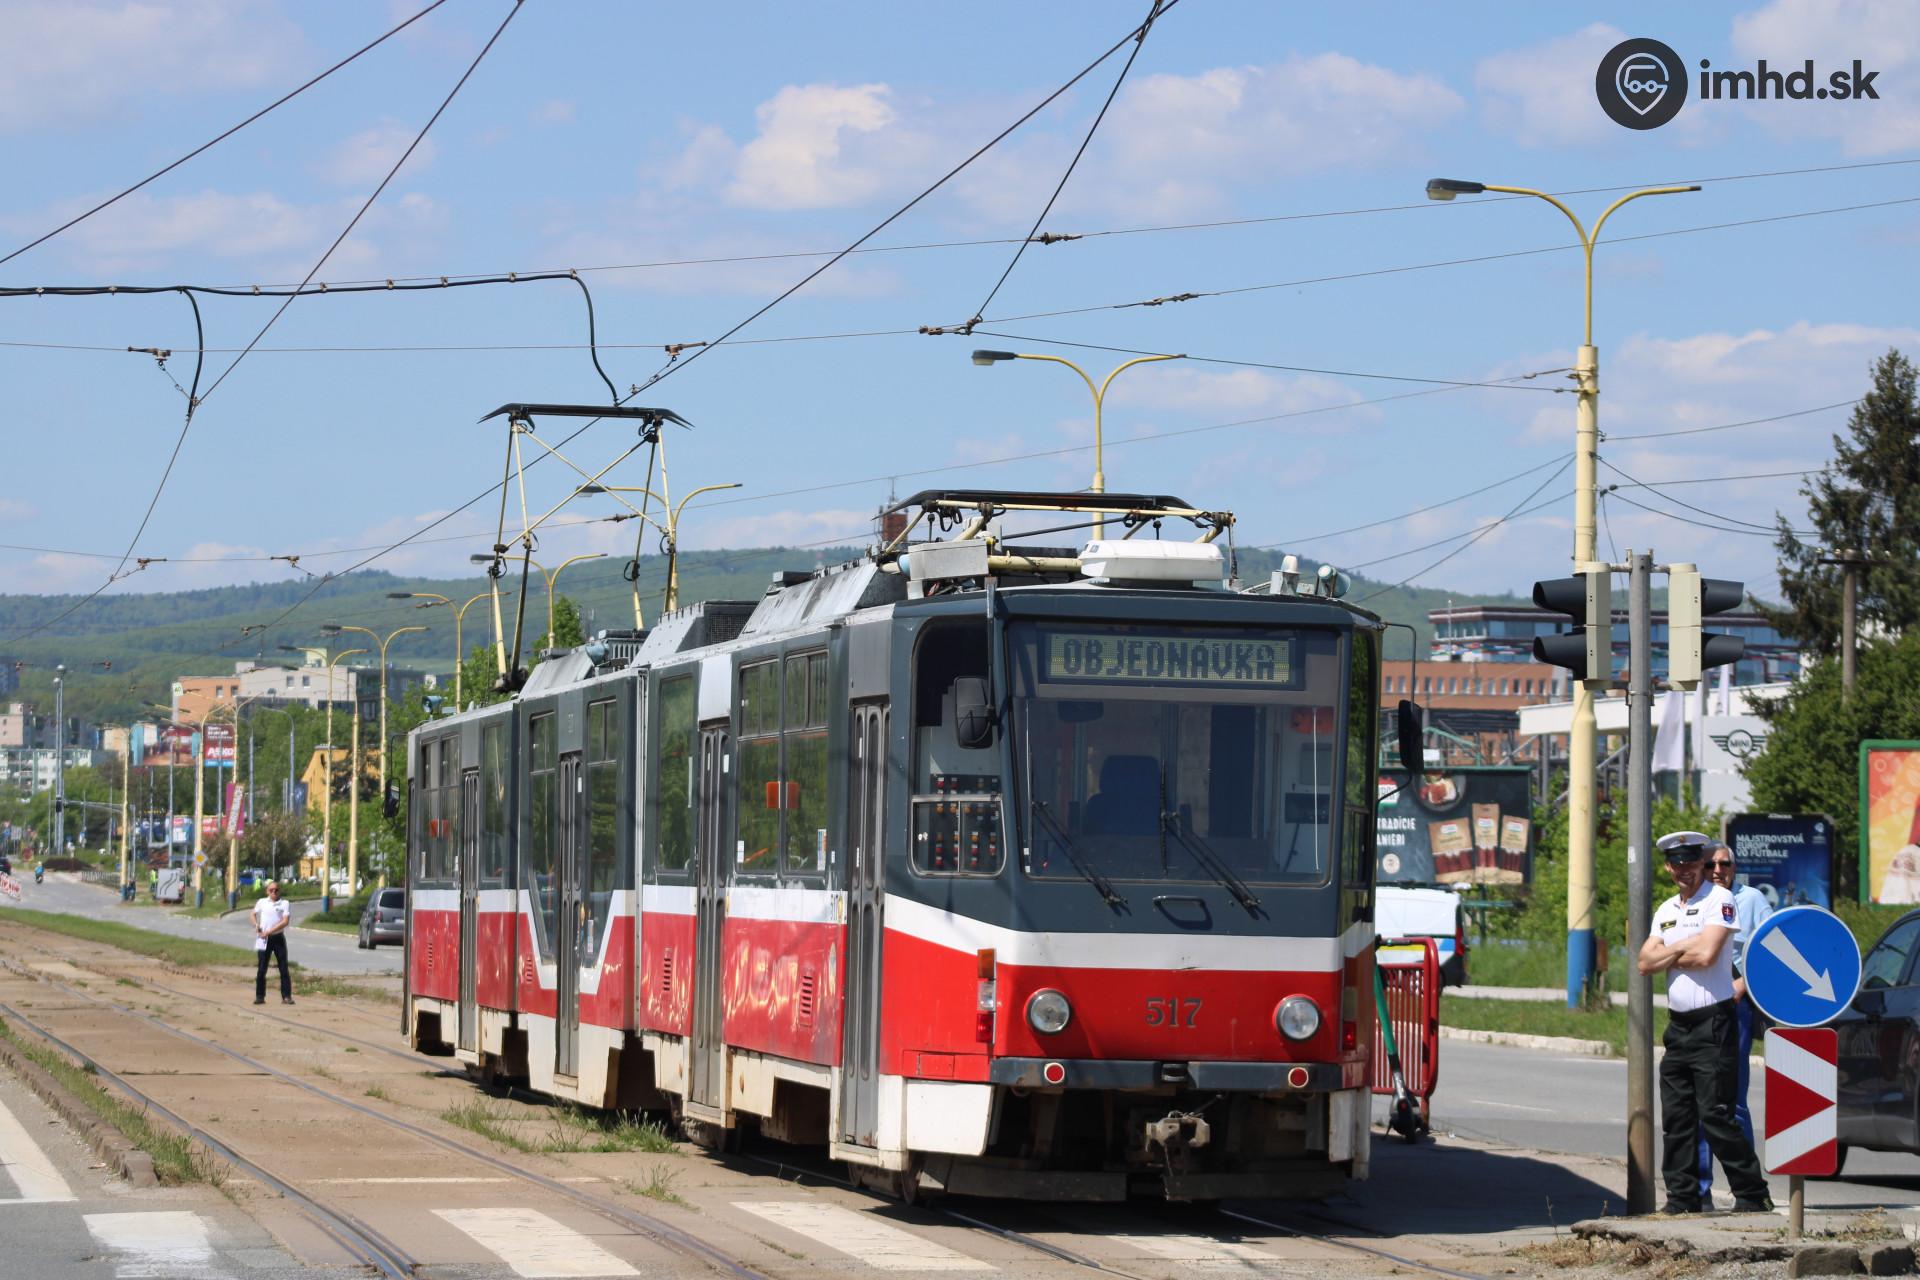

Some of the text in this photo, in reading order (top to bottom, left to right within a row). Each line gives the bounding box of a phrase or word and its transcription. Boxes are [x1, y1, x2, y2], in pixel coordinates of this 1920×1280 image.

[1063, 638, 1275, 680] OBJEDNÁVKA
[1736, 833, 1804, 843] MAJSTROVSTVÁ
[1736, 841, 1769, 850] EUROPY
[1736, 849, 1788, 857] VO FUTBALE
[1144, 997, 1203, 1028] 517
